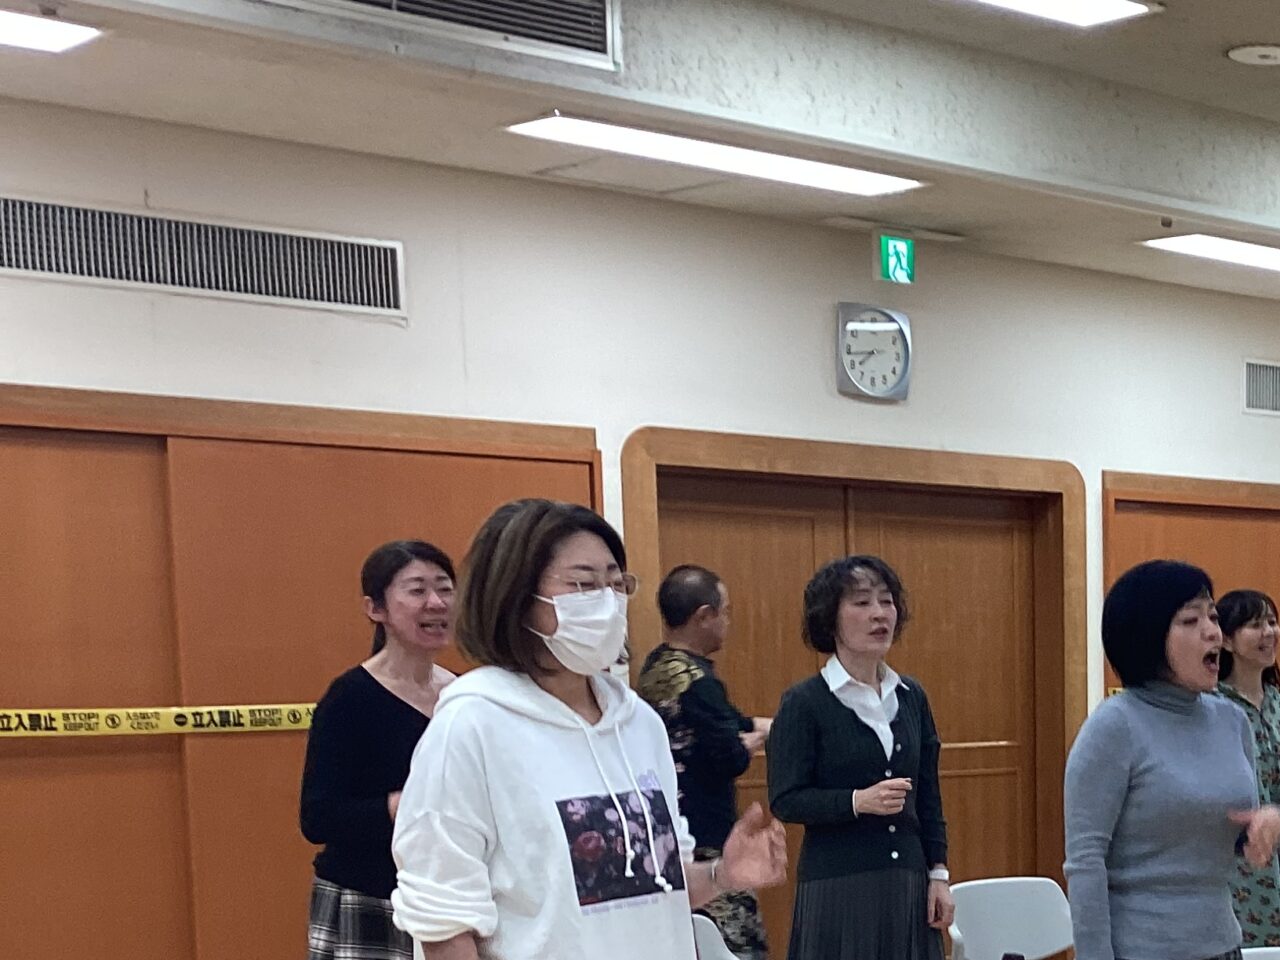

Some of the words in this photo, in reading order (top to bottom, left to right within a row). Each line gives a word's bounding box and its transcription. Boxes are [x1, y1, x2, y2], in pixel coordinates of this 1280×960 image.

[62, 712, 100, 721] STOP!
[191, 709, 245, 728] 立入禁止
[248, 708, 282, 718] STOP!
[0, 713, 58, 731] 立入禁止
